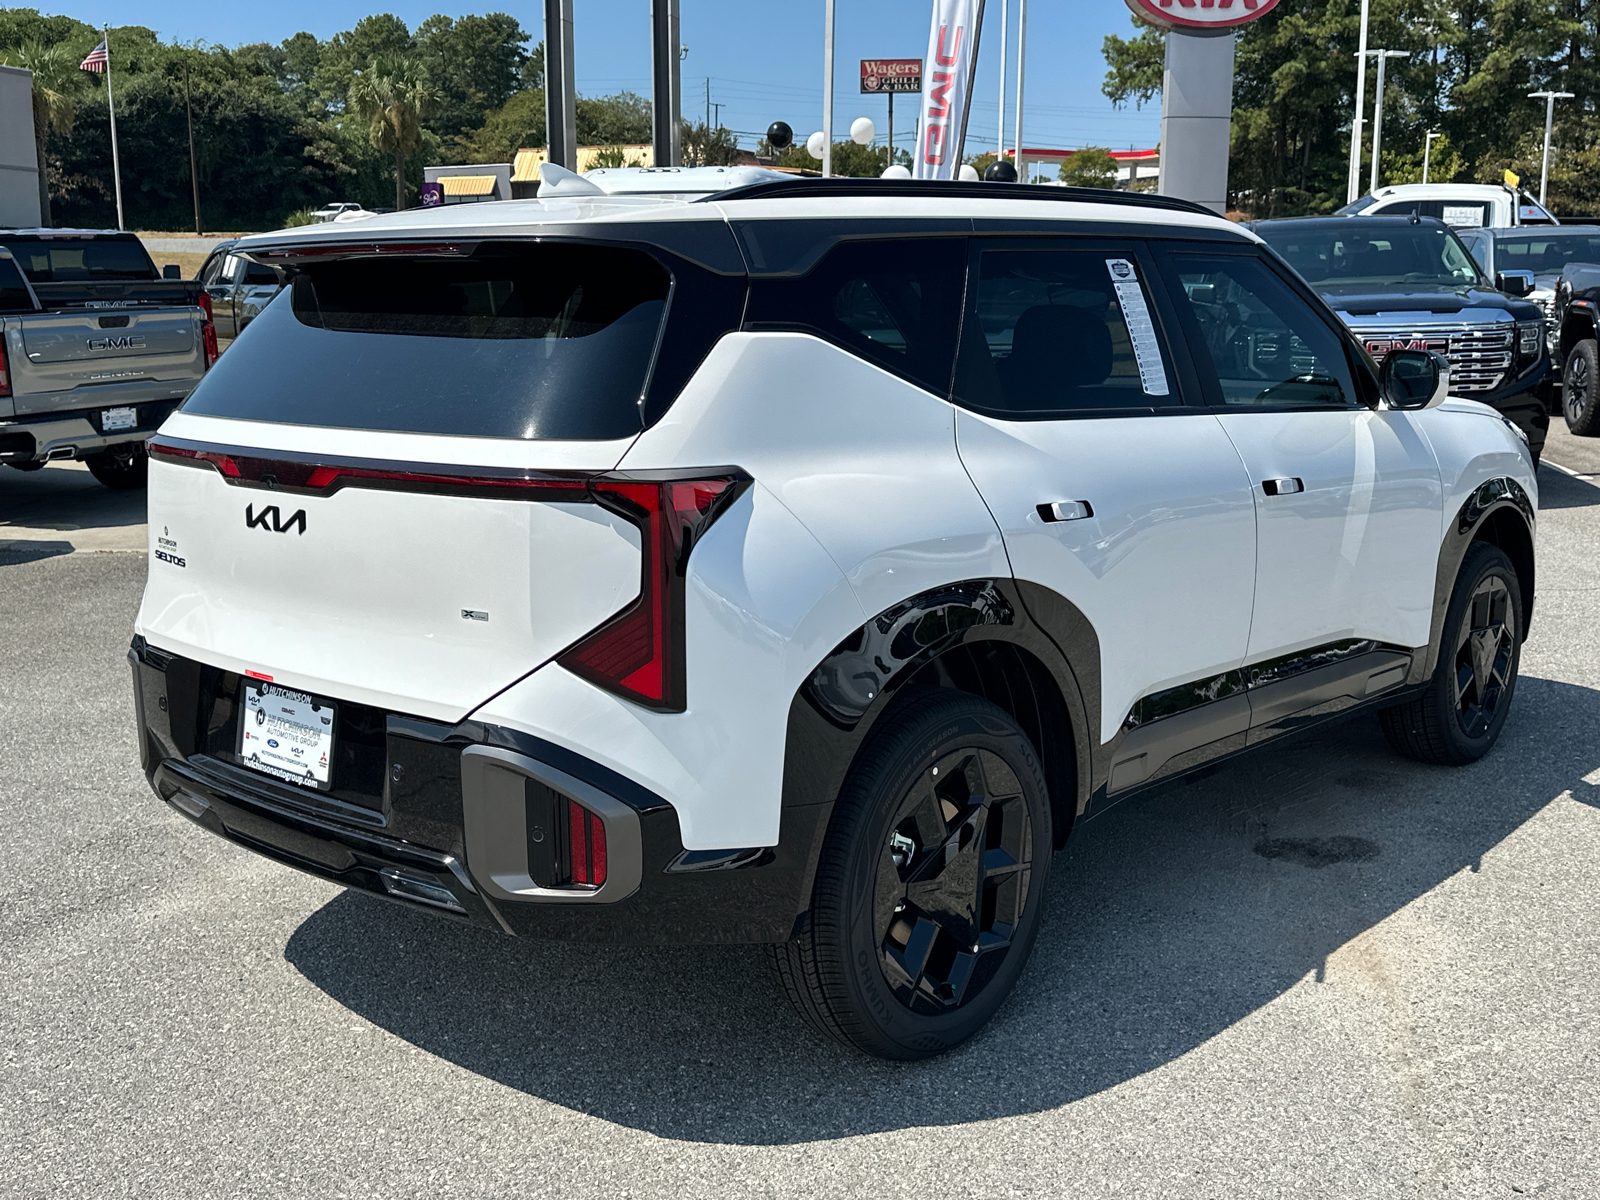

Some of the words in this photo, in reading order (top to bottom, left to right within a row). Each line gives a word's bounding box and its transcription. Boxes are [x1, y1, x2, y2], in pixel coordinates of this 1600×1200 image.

[863, 61, 919, 76] Wagers
[87, 335, 146, 352] GMC
[1366, 339, 1446, 354] GMC
[245, 502, 306, 536] KIA
[155, 549, 186, 568] SELTOS
[269, 685, 312, 704] HUTCHINSON
[281, 707, 296, 715] GMC
[266, 727, 299, 743] AUTOMOTIVE
[300, 736, 318, 748] GROUP
[243, 757, 318, 788] Hutchinsonautogroup.com
[858, 949, 894, 1026] KUMHO
